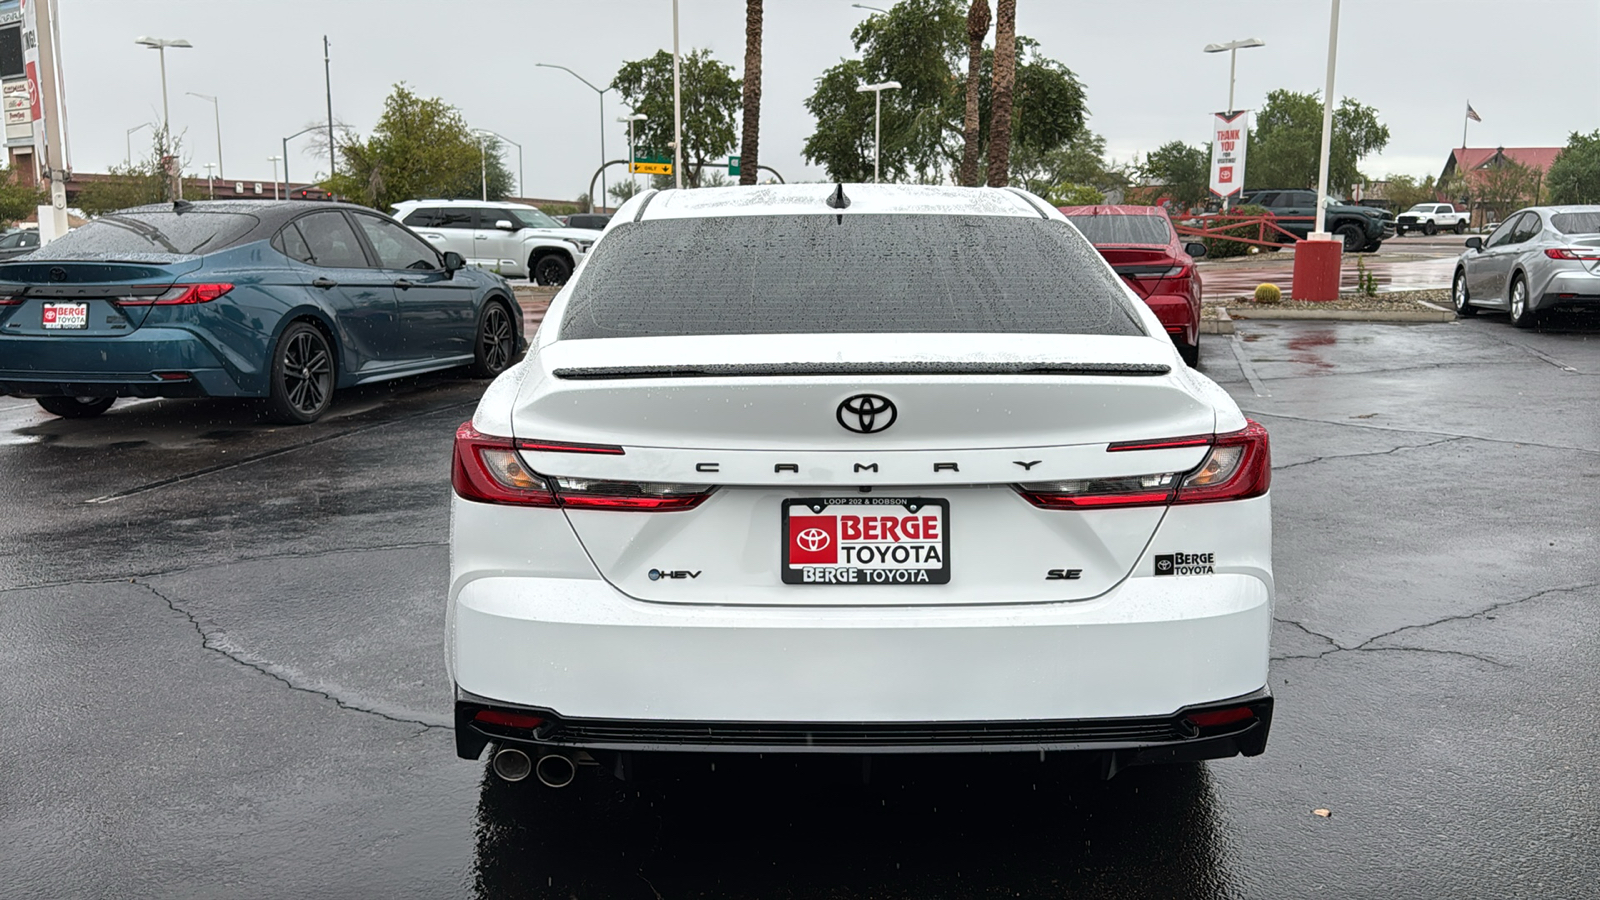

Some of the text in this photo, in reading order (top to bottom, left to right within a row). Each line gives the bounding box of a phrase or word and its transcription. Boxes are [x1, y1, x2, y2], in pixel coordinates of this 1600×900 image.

[1217, 130, 1239, 141] THANK
[1221, 141, 1235, 152] YOU
[58, 307, 85, 316] BERGE
[696, 460, 1042, 473] CAMRY
[840, 515, 939, 543] BERGE
[841, 545, 942, 564] TOYOTA
[1175, 552, 1214, 565] BERGE
[803, 567, 929, 584] BERGE TOYOTA
[1045, 569, 1083, 580] SE
[1175, 565, 1214, 575] TOYOTA
